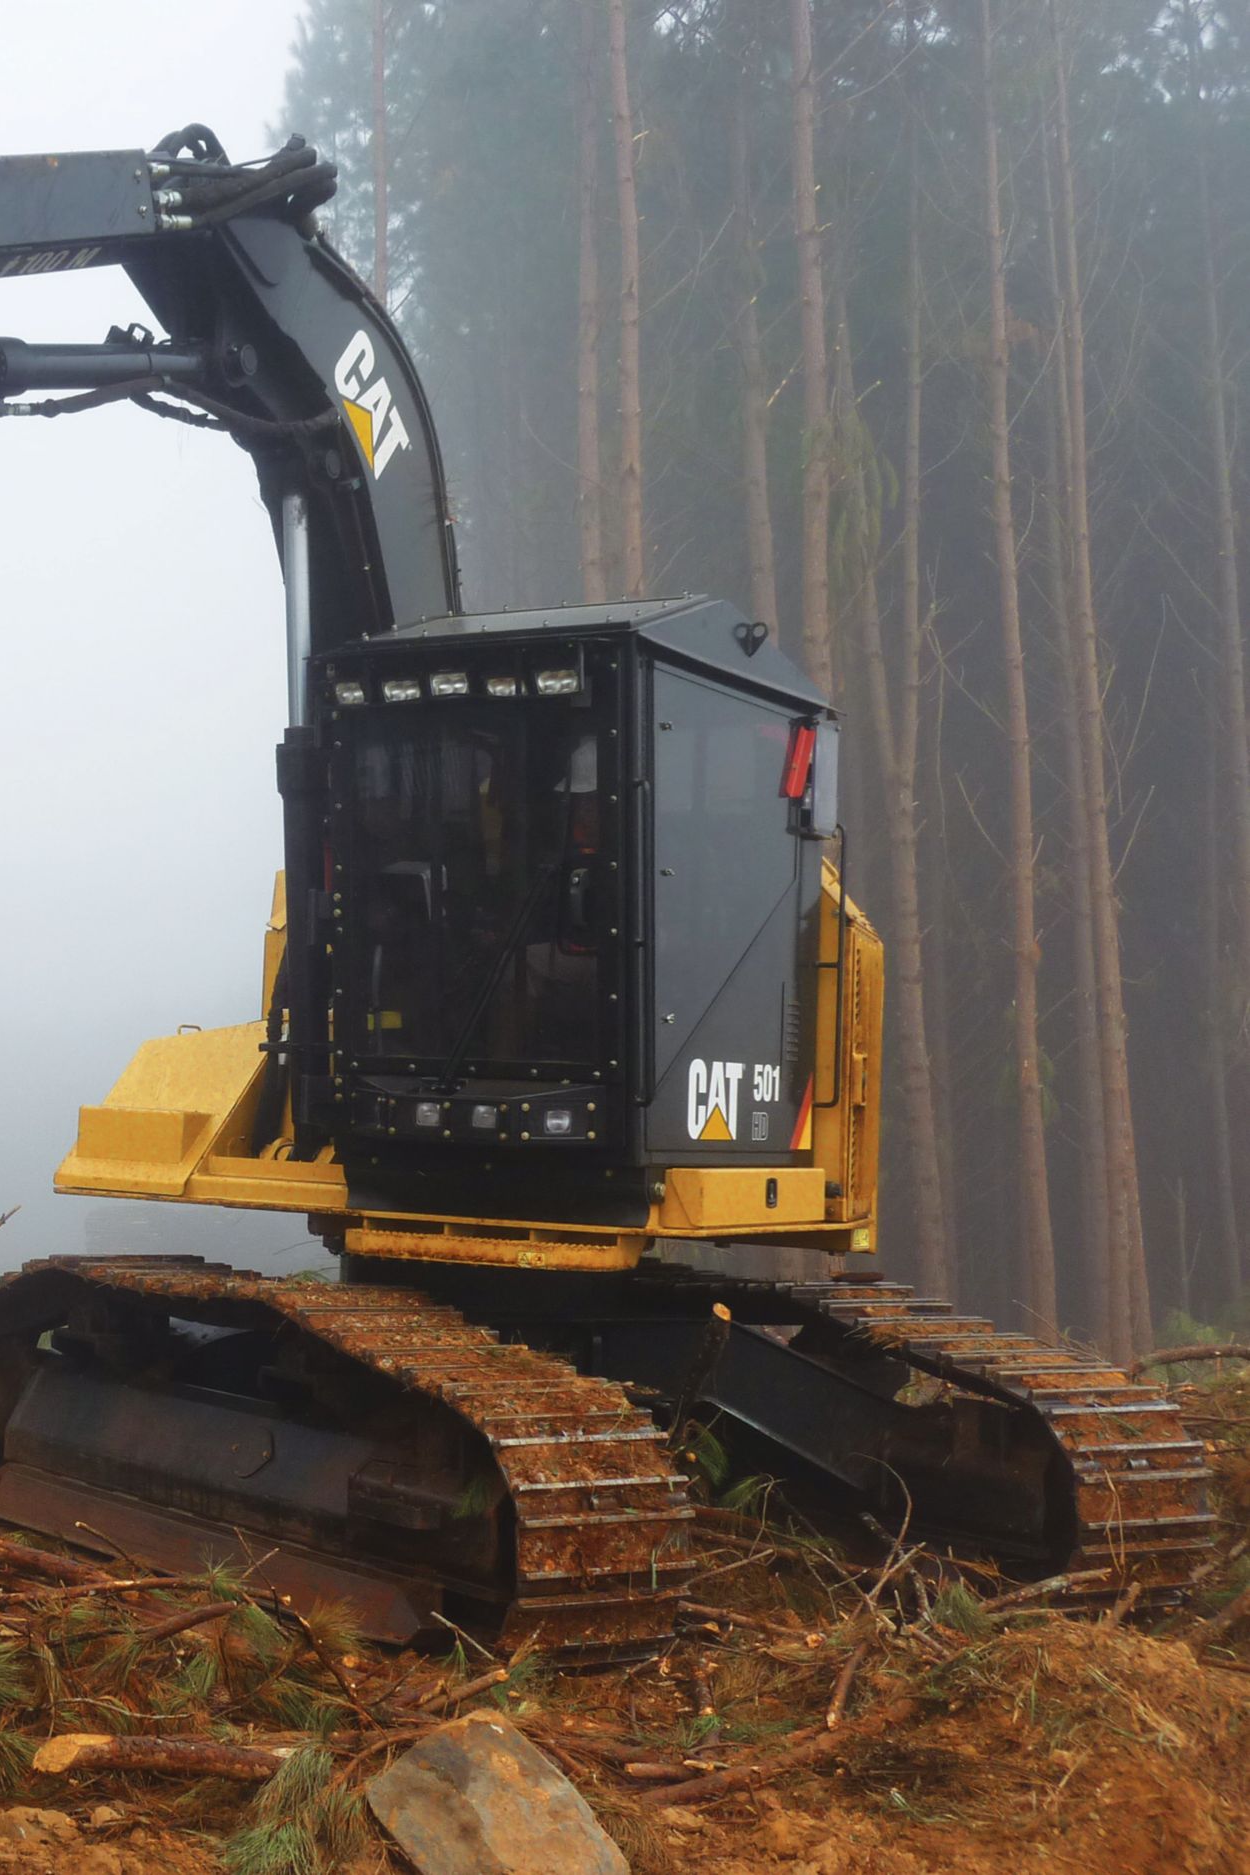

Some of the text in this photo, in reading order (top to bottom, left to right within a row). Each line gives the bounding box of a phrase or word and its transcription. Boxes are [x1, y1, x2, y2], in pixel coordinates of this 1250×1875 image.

[334, 329, 410, 481] CAT
[687, 1058, 781, 1140] CAT 501
[752, 1111, 769, 1141] HD
